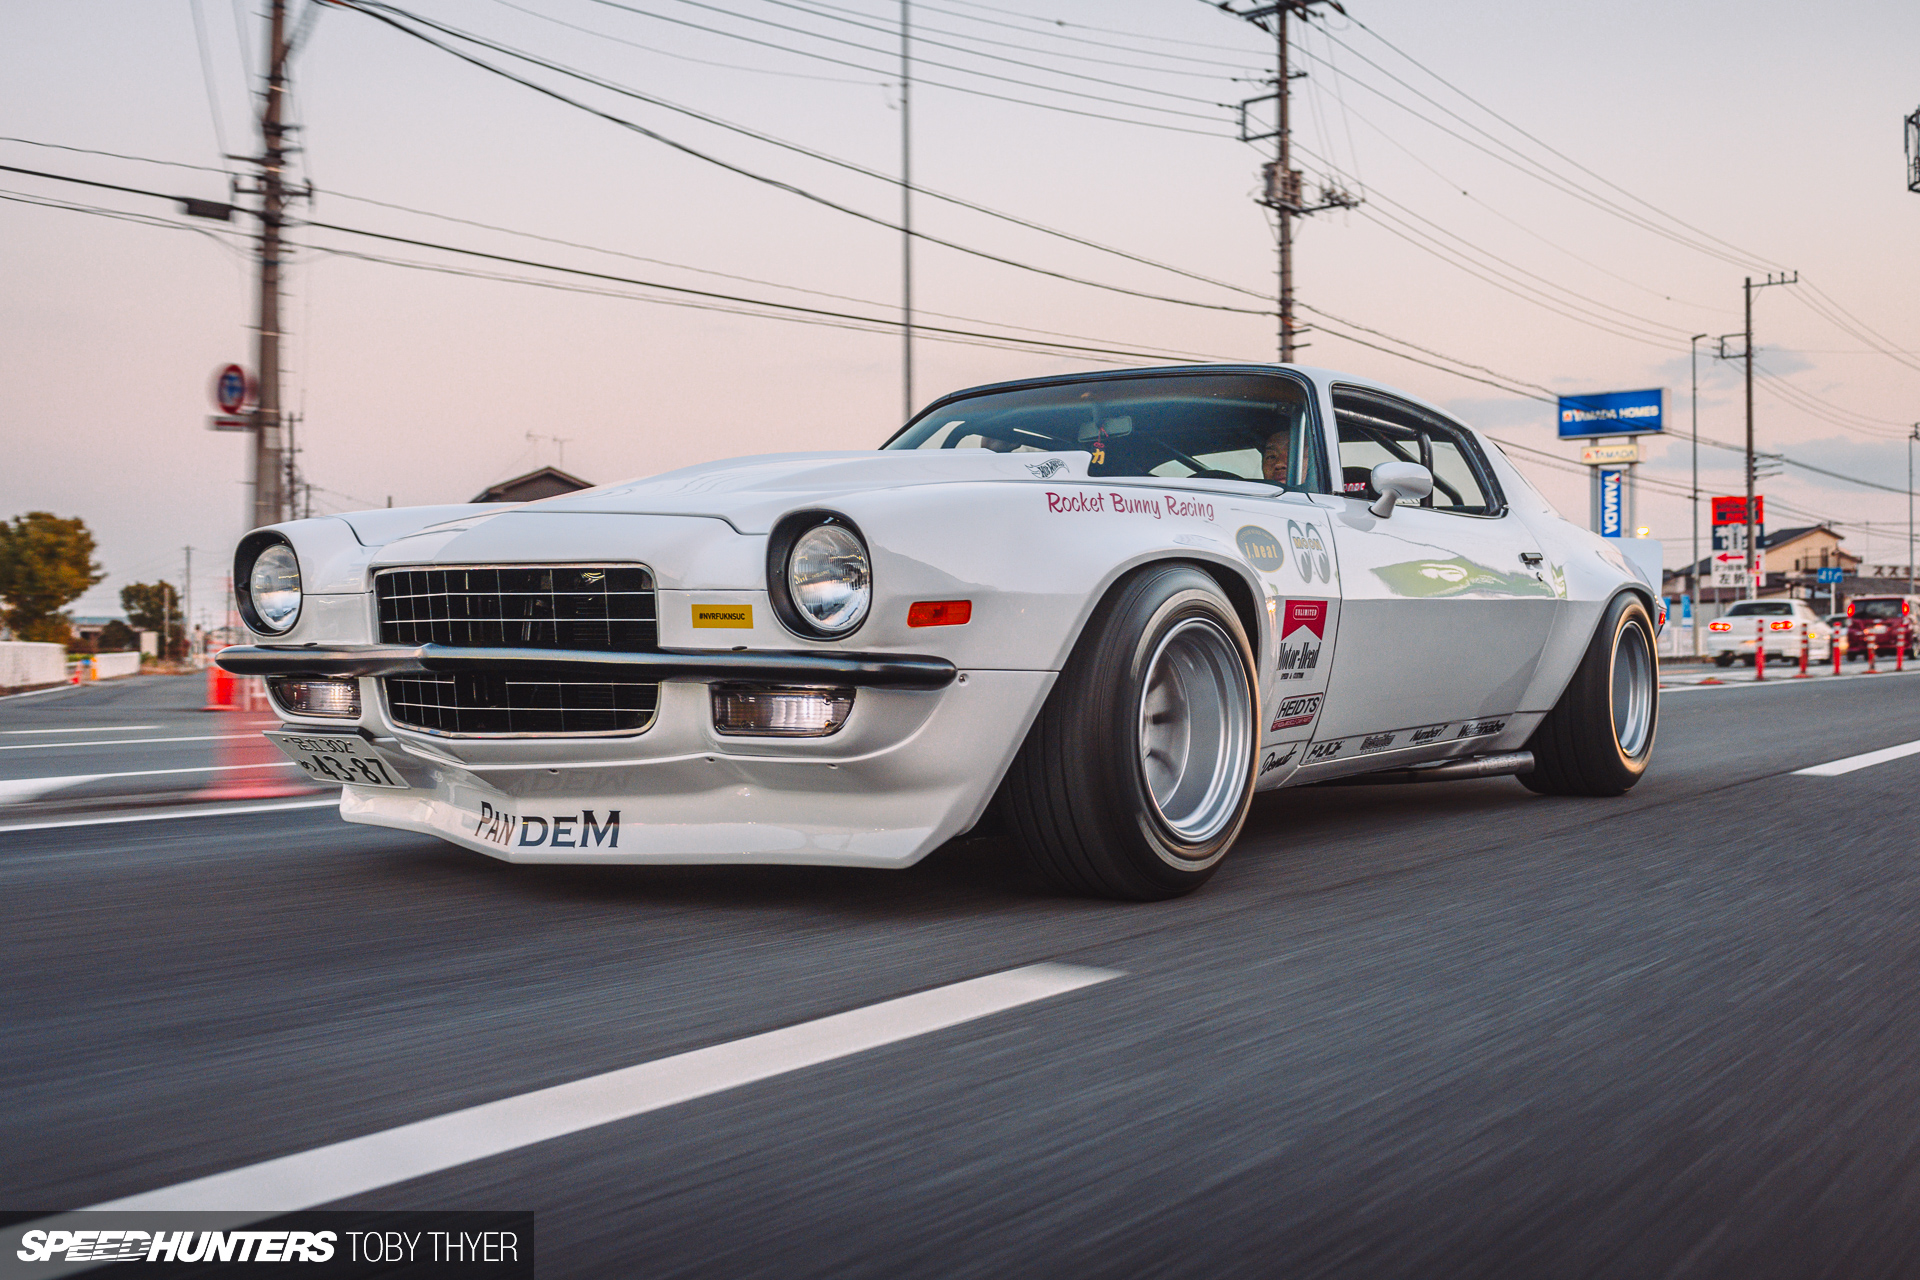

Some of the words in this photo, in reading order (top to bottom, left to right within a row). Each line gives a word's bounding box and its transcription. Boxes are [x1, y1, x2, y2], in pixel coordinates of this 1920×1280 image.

[1572, 408, 1617, 422] YAMADA
[1619, 405, 1659, 418] HOMES
[1091, 448, 1105, 465] 力
[1594, 449, 1635, 459] YAMADA
[1045, 491, 1104, 513] Rocket
[1109, 493, 1161, 519] Bunny
[1164, 495, 1214, 521] Racing
[1604, 472, 1620, 534] YAMADA
[1292, 536, 1323, 551] MOON
[1277, 697, 1320, 718] HEIDTS
[311, 754, 395, 785] 43-87
[474, 801, 621, 848] PANDEM
